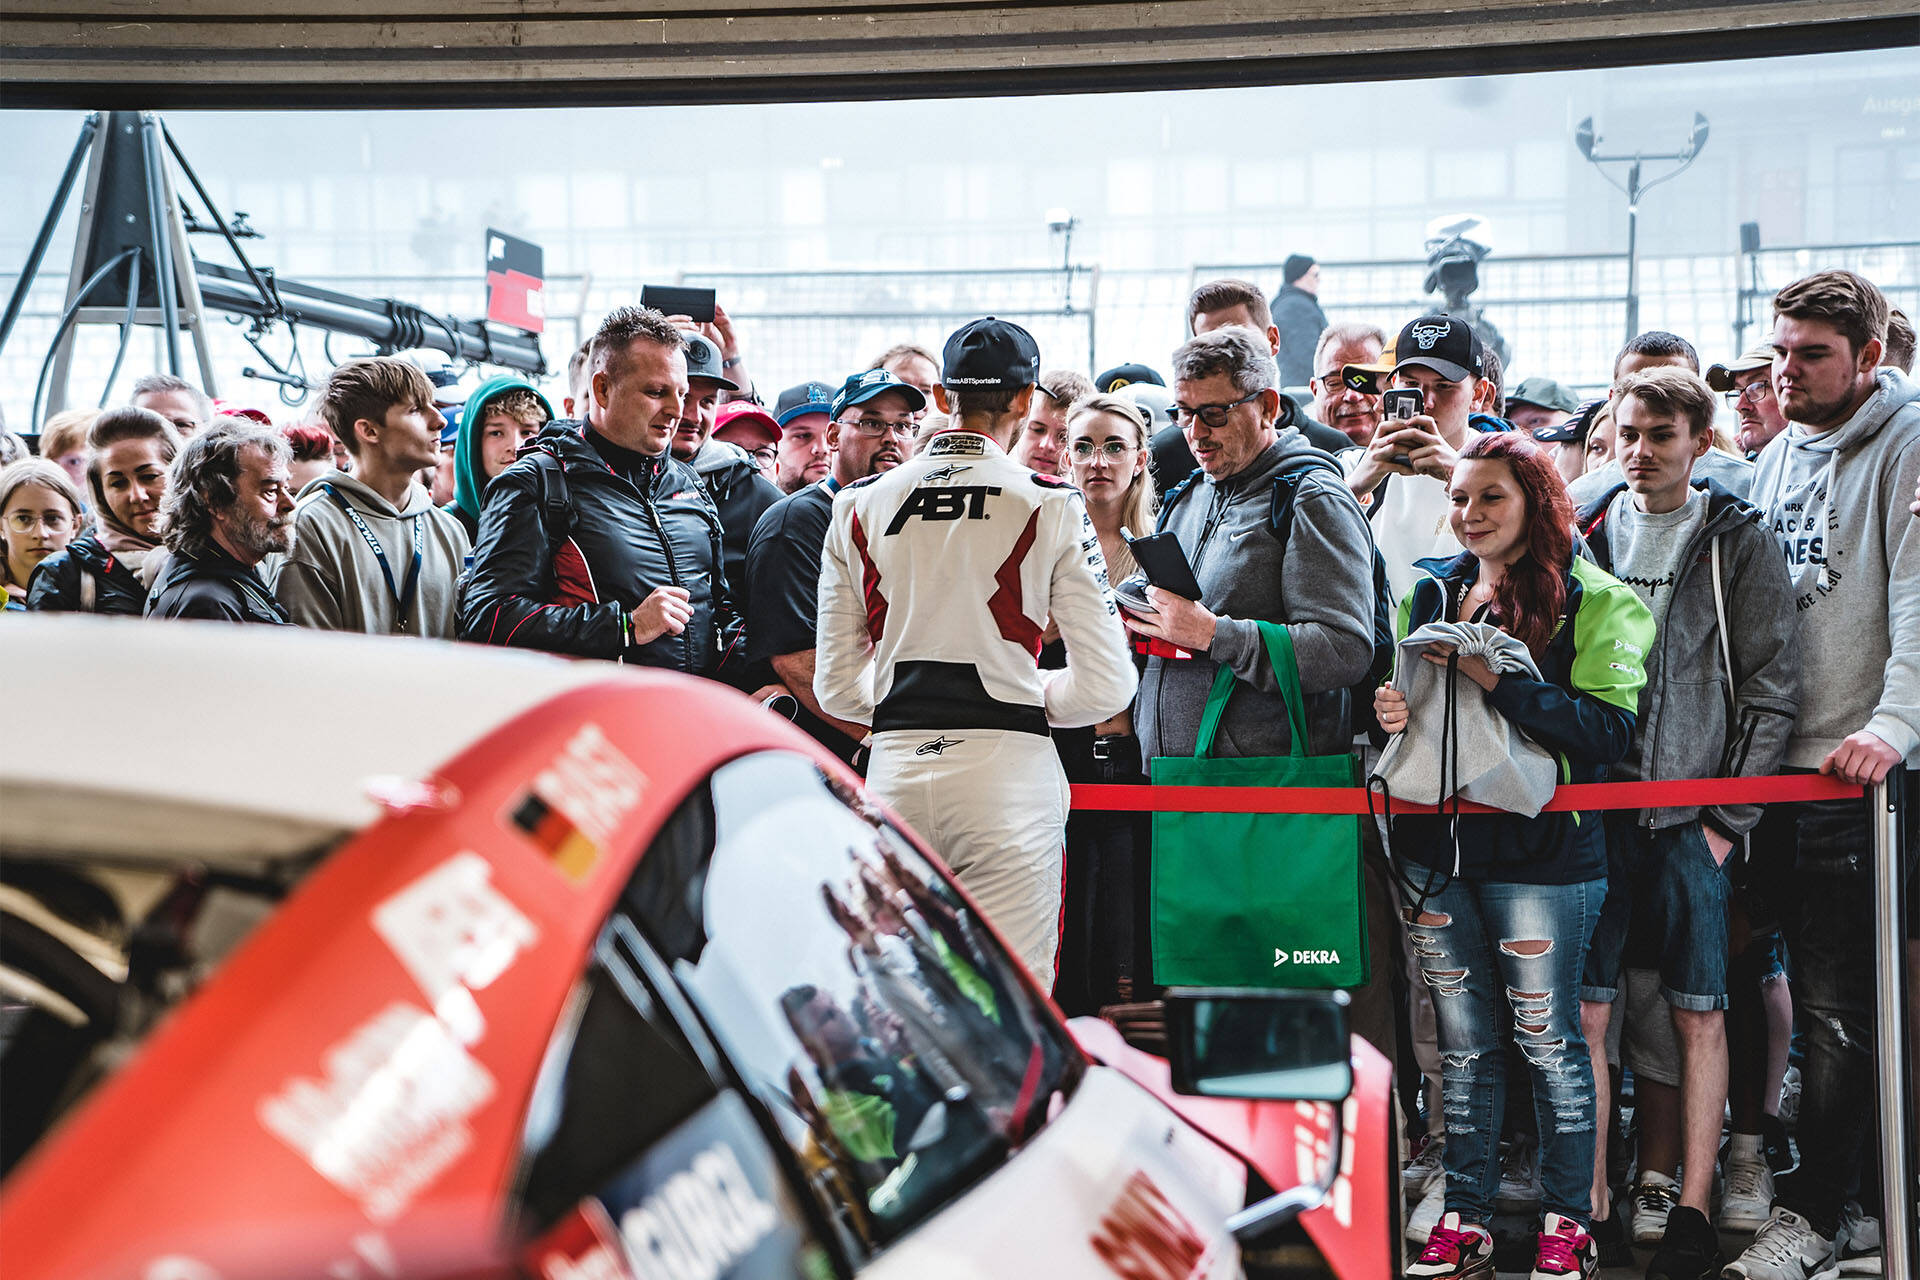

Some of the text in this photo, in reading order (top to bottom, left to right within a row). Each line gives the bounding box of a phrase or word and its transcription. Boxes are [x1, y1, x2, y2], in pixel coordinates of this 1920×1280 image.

[345, 507, 383, 555] DTM.COM
[1784, 537, 1824, 566] NES
[1293, 950, 1340, 964] DEKRA
